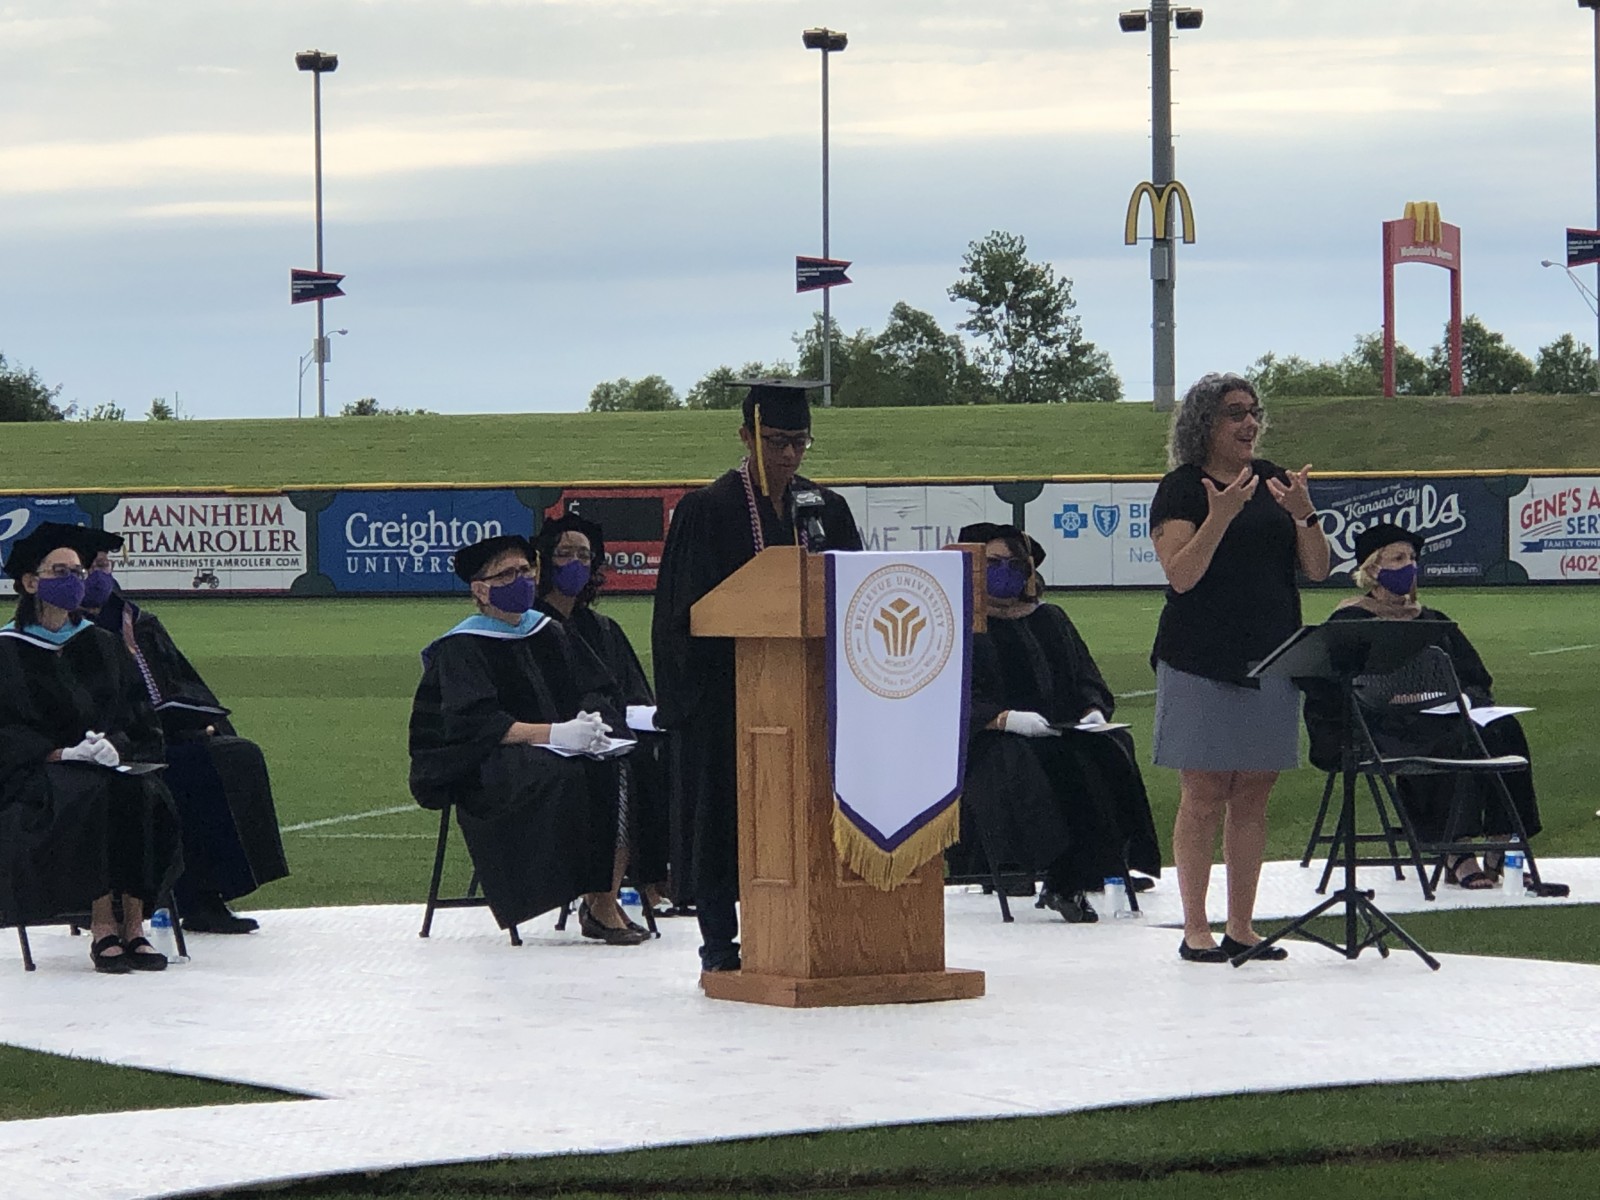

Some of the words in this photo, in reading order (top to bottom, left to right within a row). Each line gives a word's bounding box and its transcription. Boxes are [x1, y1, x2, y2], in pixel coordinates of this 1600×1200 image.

[1344, 495, 1394, 520] Kansas
[1393, 487, 1420, 506] City
[1520, 487, 1582, 530] GENE'S
[123, 503, 284, 528] MANNHEIM
[1567, 513, 1600, 535] SER
[345, 509, 502, 557] Creighton
[1544, 540, 1573, 548] FAMILY
[116, 557, 300, 568] WW.MANNHEIMSTEAMROLLER.COM
[347, 556, 456, 573] UNIVERS
[1426, 564, 1478, 576] royals.com
[855, 577, 892, 630] BELLEVUE
[896, 575, 945, 628] UNIVERSITY
